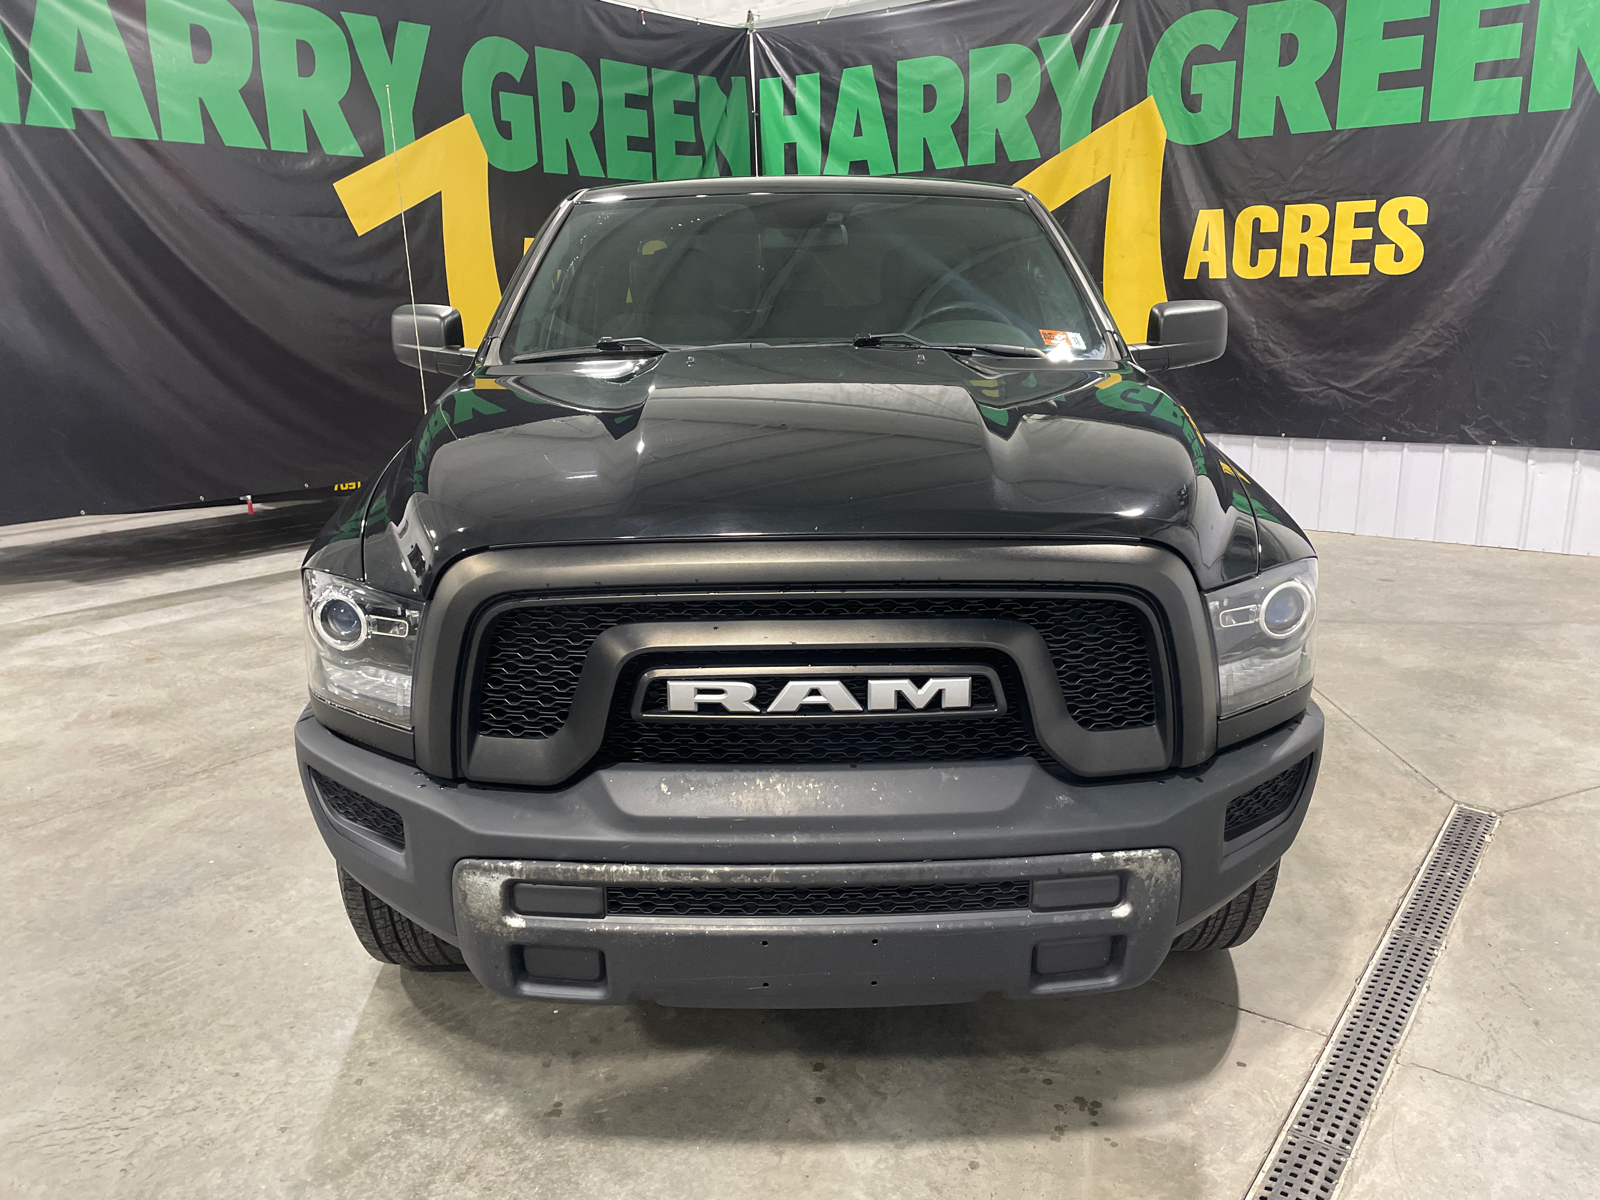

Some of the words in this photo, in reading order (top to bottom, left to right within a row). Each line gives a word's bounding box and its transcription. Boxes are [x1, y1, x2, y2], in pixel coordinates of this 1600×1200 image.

[0, 0, 431, 157] ARRY
[462, 36, 751, 182] GREEN
[759, 23, 1123, 177] HARRY
[333, 114, 502, 349] 7
[1014, 95, 1167, 345] 7
[1184, 196, 1428, 280] ACRES
[667, 677, 972, 713] RAM
